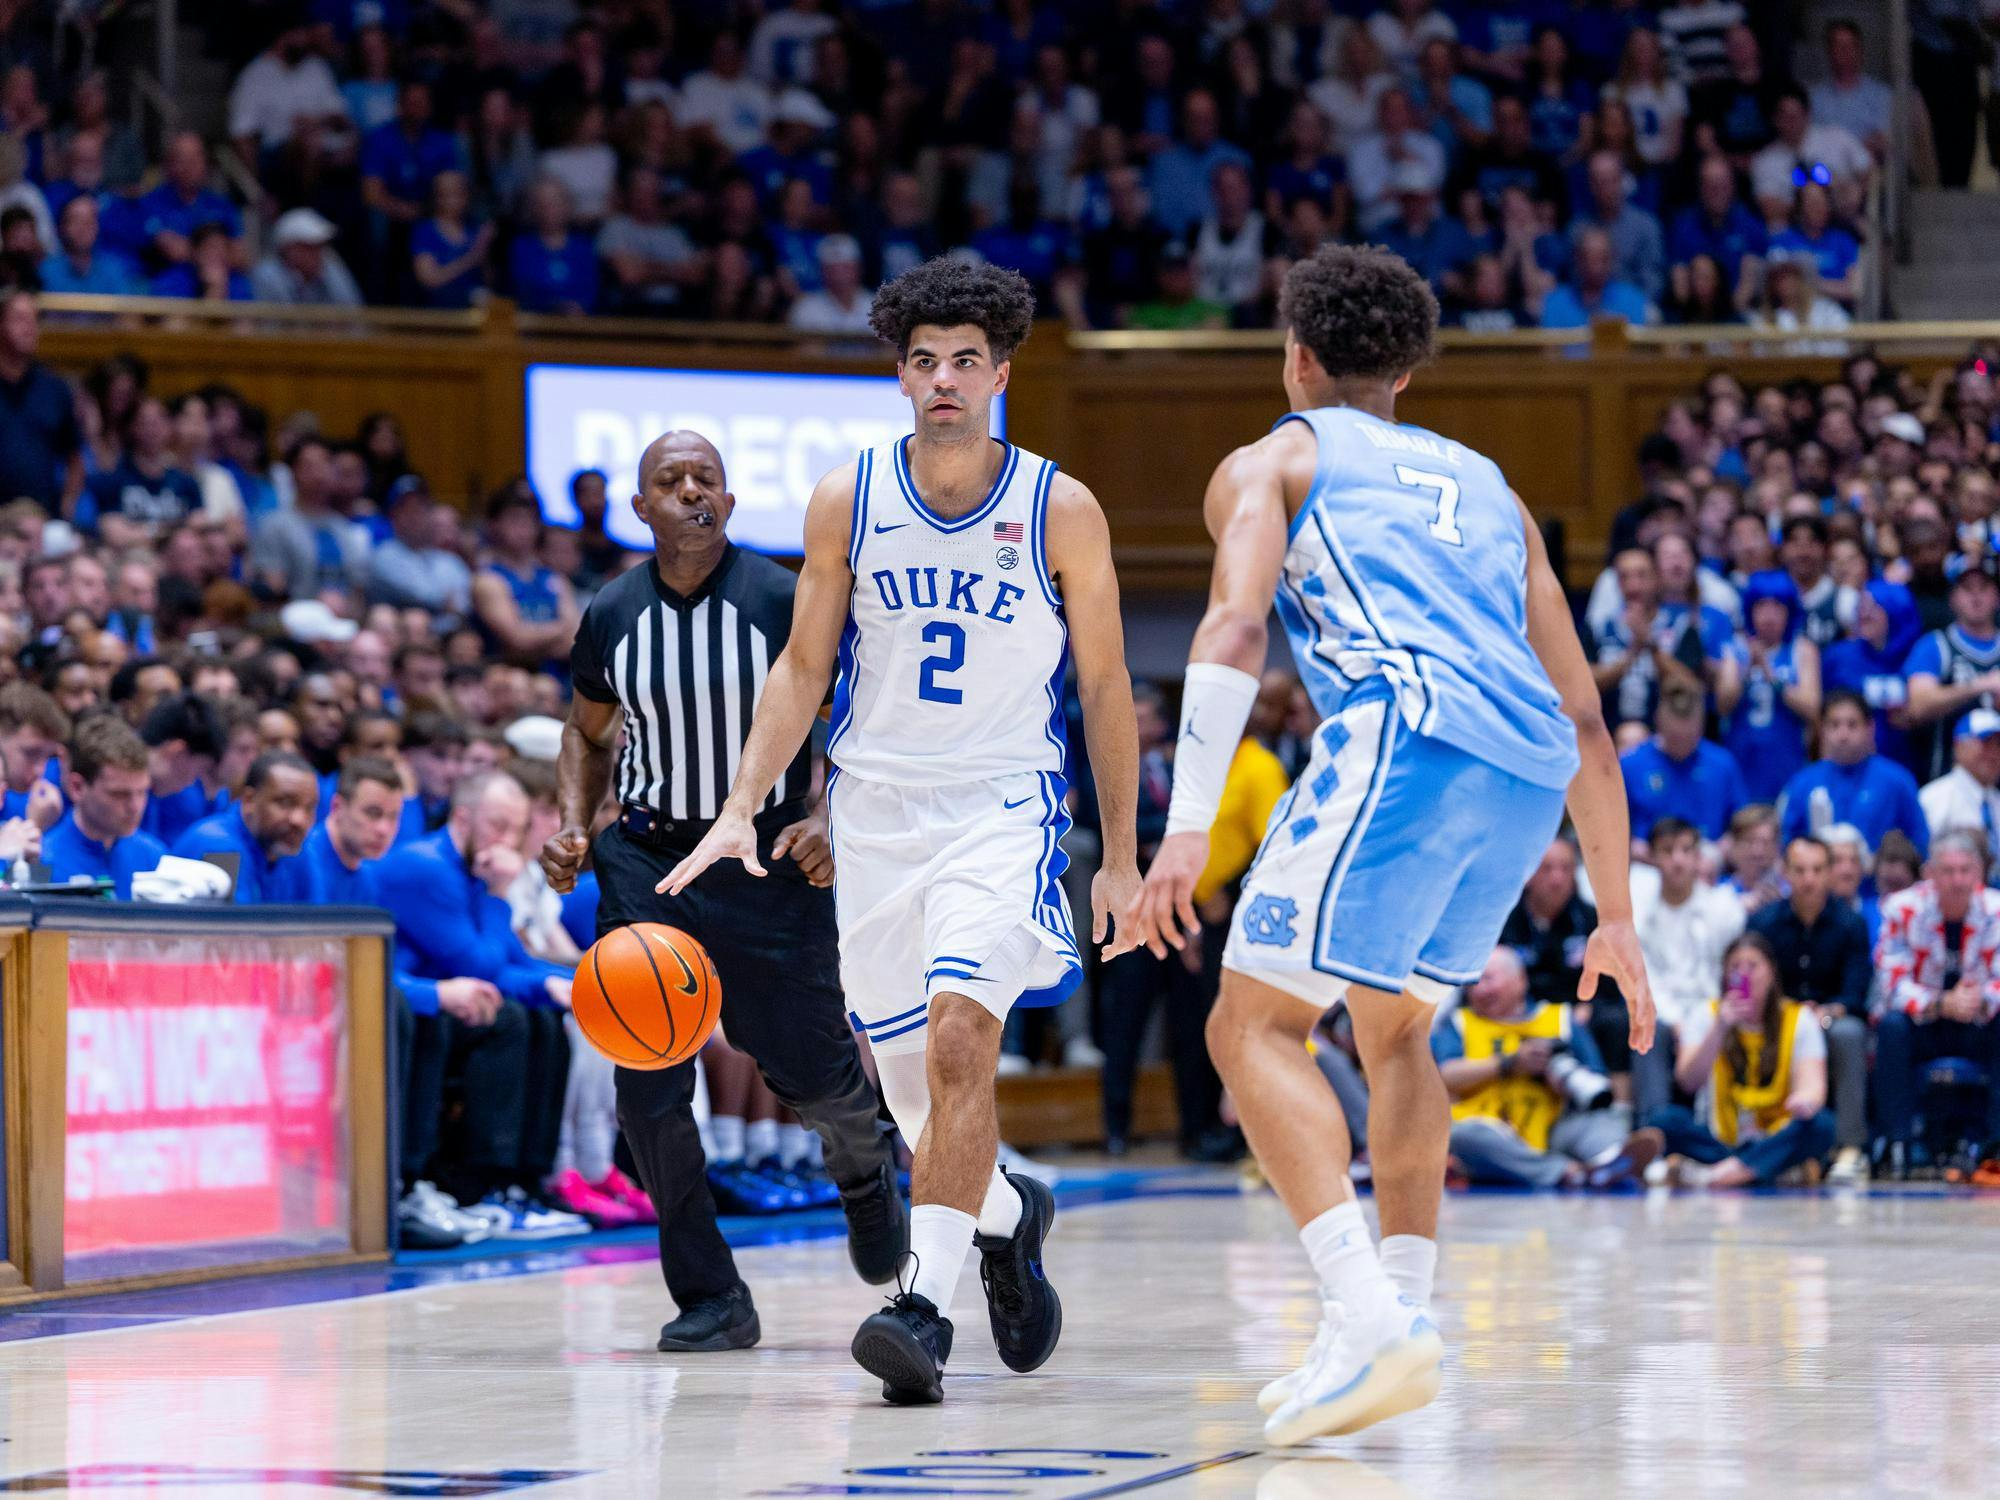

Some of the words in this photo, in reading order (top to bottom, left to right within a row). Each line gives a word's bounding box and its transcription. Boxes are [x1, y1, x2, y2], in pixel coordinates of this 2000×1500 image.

[1393, 463, 1464, 547] 7
[872, 567, 1026, 625] DUKE
[919, 620, 966, 705] 2
